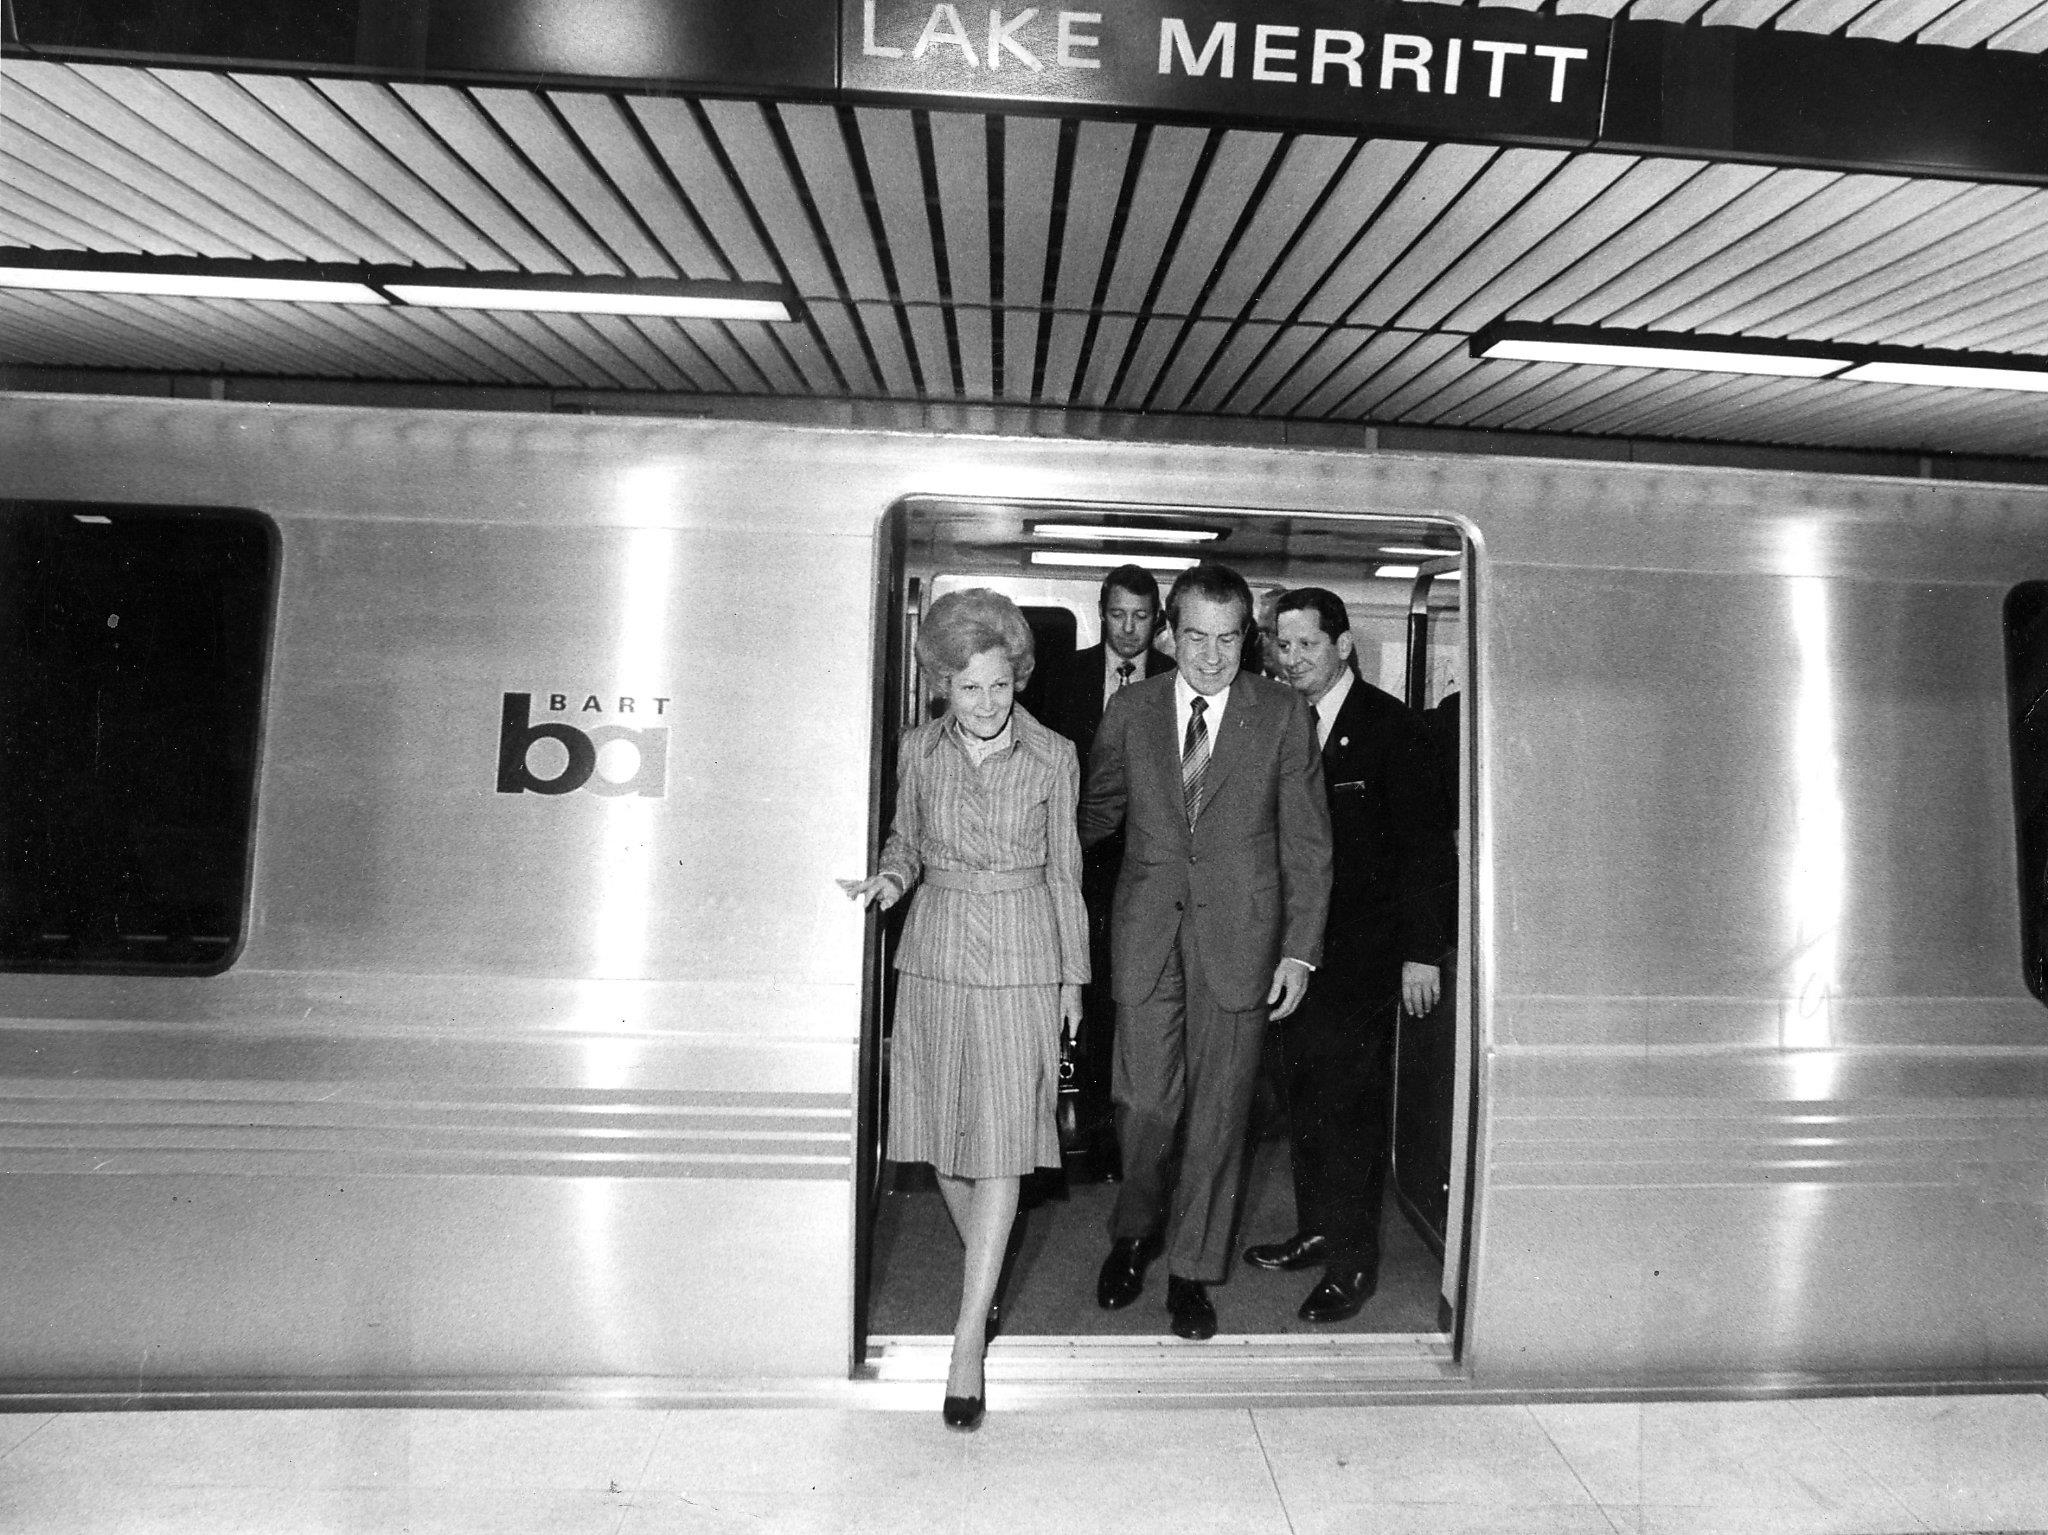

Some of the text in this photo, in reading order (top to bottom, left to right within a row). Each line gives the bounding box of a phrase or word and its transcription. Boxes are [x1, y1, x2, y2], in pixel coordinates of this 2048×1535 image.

[863, 0, 1588, 102] LAKE MERRITT
[550, 694, 669, 714] BART
